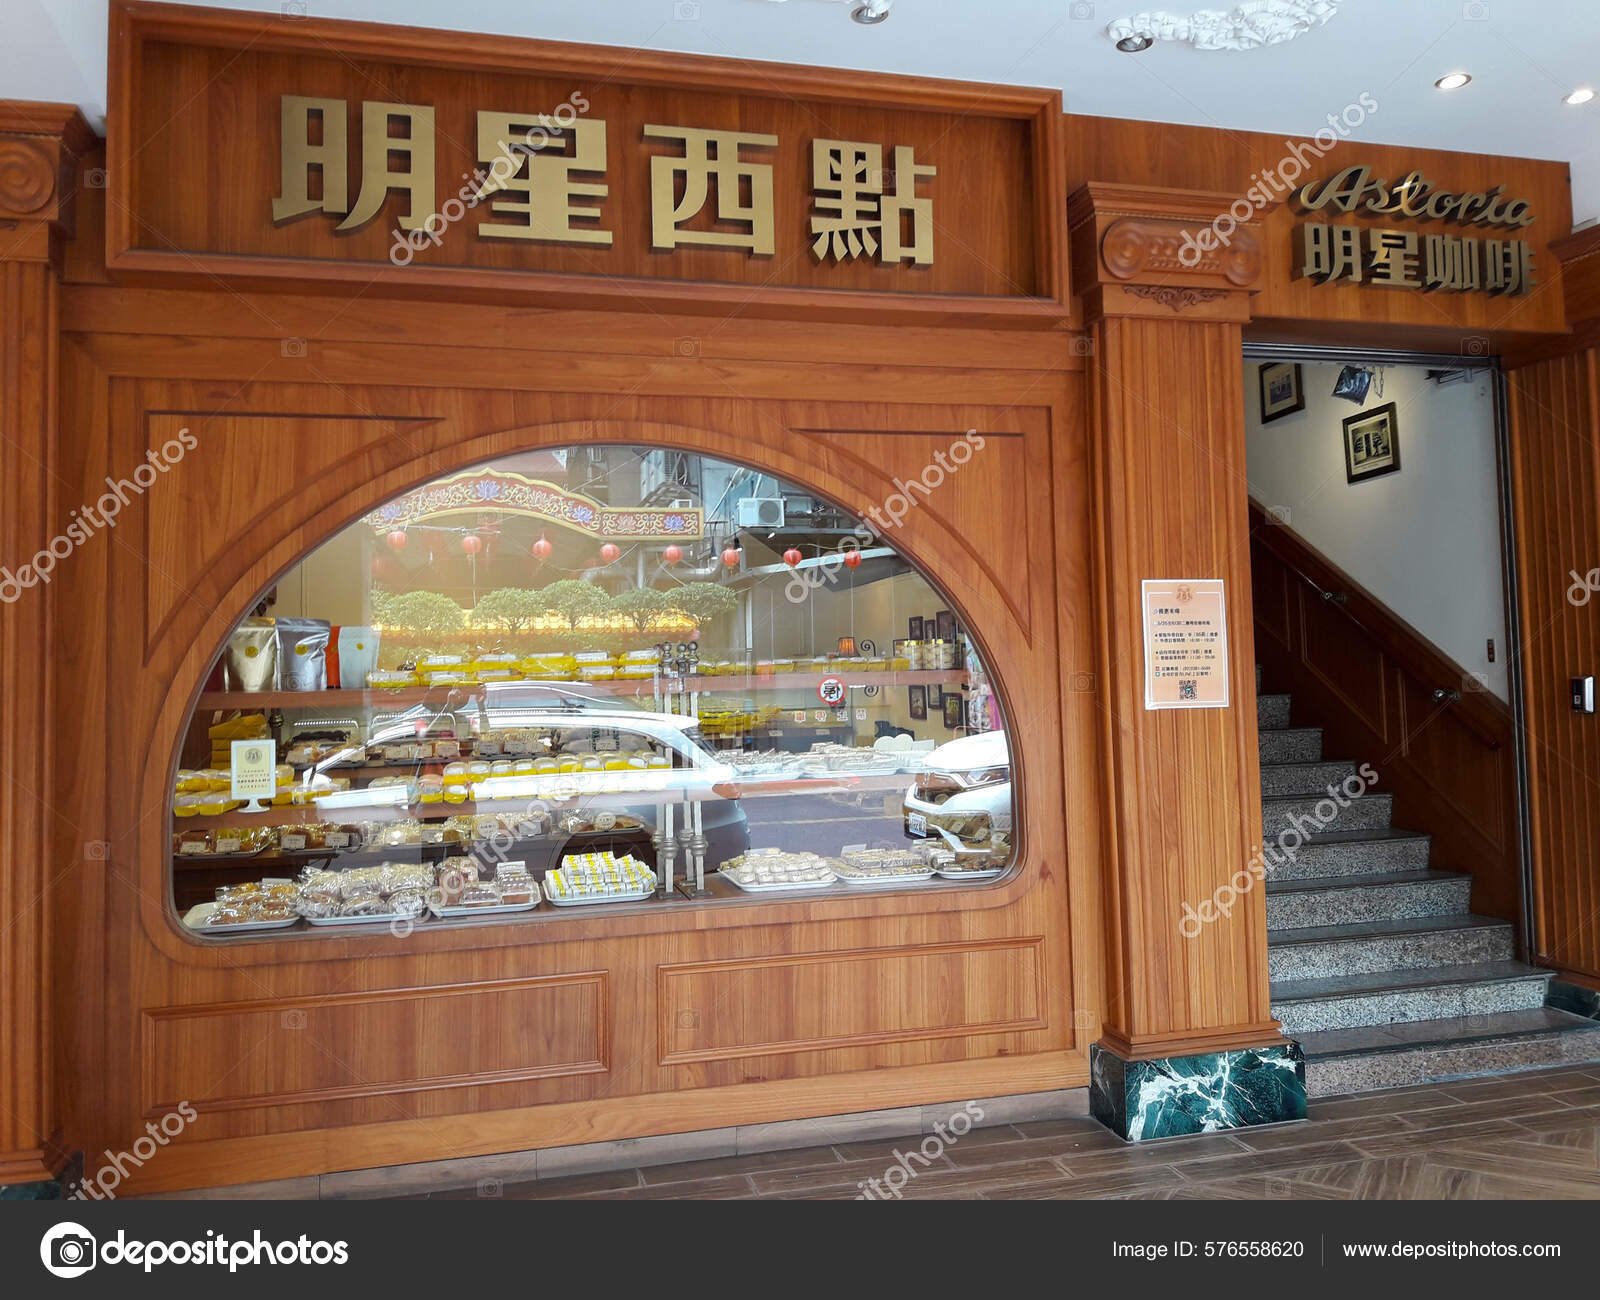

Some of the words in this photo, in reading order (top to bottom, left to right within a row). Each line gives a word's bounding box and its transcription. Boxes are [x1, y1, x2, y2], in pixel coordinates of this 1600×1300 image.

[272, 95, 938, 266] 明星西點
[1298, 164, 1537, 227] Astoria
[1302, 221, 1539, 294] 明星咖啡
